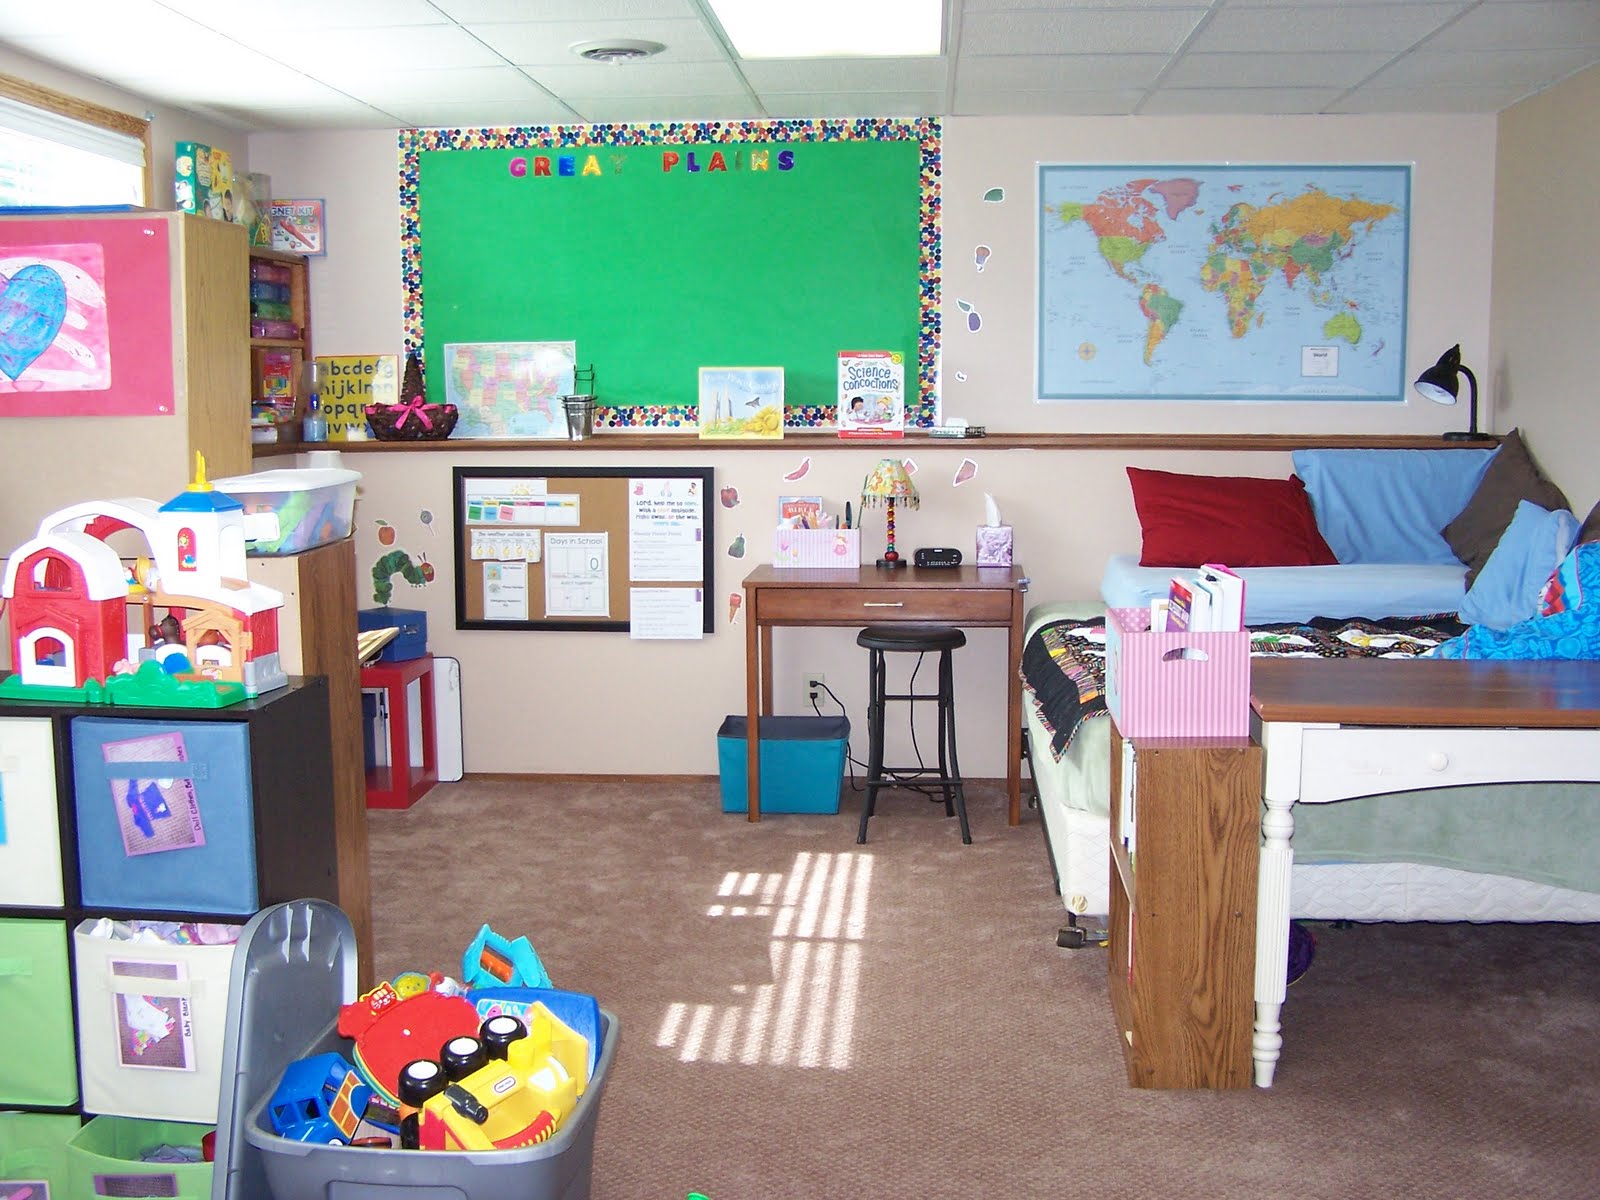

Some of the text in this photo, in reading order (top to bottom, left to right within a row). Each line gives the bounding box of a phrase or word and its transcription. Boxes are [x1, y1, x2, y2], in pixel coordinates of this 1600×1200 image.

[662, 149, 796, 174] PLAINS
[297, 206, 315, 217] KIT
[847, 366, 892, 381] Science
[550, 537, 568, 546] Days
[577, 537, 603, 545] School
